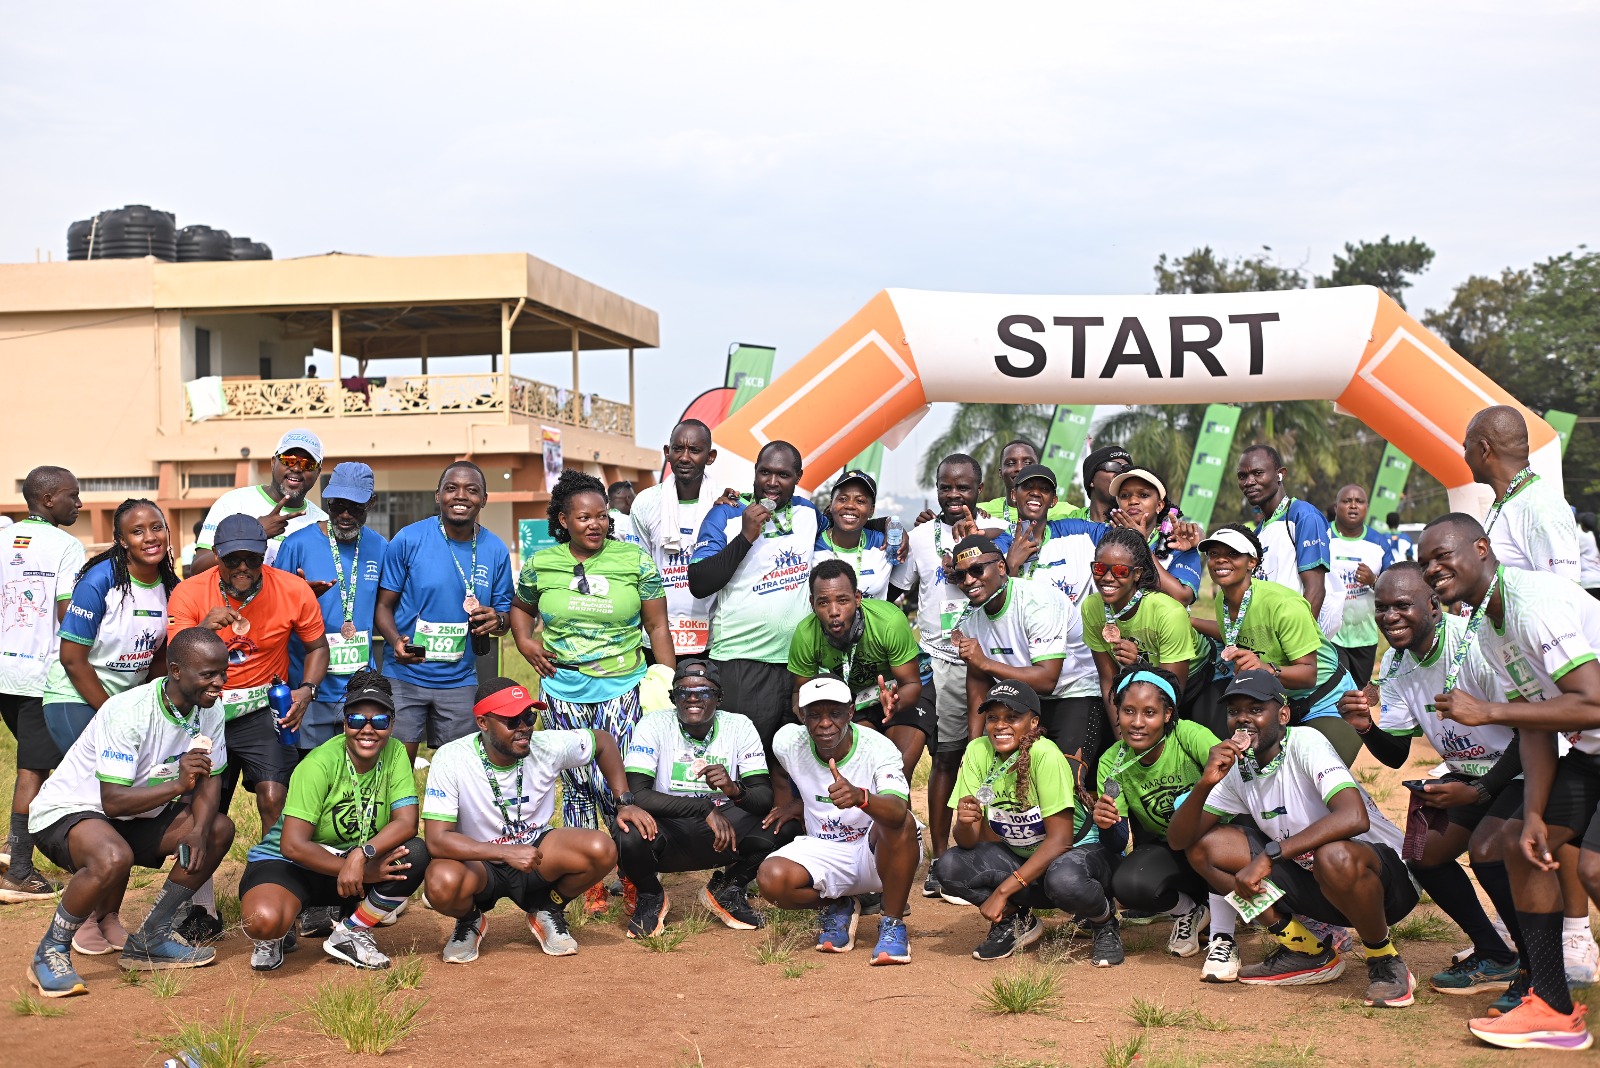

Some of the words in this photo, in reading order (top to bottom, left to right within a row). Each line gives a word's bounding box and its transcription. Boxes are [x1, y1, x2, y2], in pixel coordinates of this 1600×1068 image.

[994, 312, 1280, 378] START
[745, 376, 764, 388] KCB
[762, 563, 808, 582] KYAMBOGO
[753, 580, 778, 592] ULTRA
[67, 601, 94, 620] ivana
[568, 605, 613, 614] MARATHON
[438, 625, 465, 635] 25Km
[679, 620, 707, 629] 50Km
[427, 637, 454, 652] 169
[334, 647, 359, 663] 170
[105, 660, 131, 668] ULTRA
[247, 686, 268, 700] 25K
[101, 746, 135, 763] nivana
[706, 754, 728, 765] 5Km
[1461, 763, 1490, 775] 25Km
[1140, 774, 1182, 792] MARCO'S
[1011, 813, 1042, 824] 10Km
[1001, 824, 1036, 839] 256
[1233, 894, 1255, 918] 5Km
